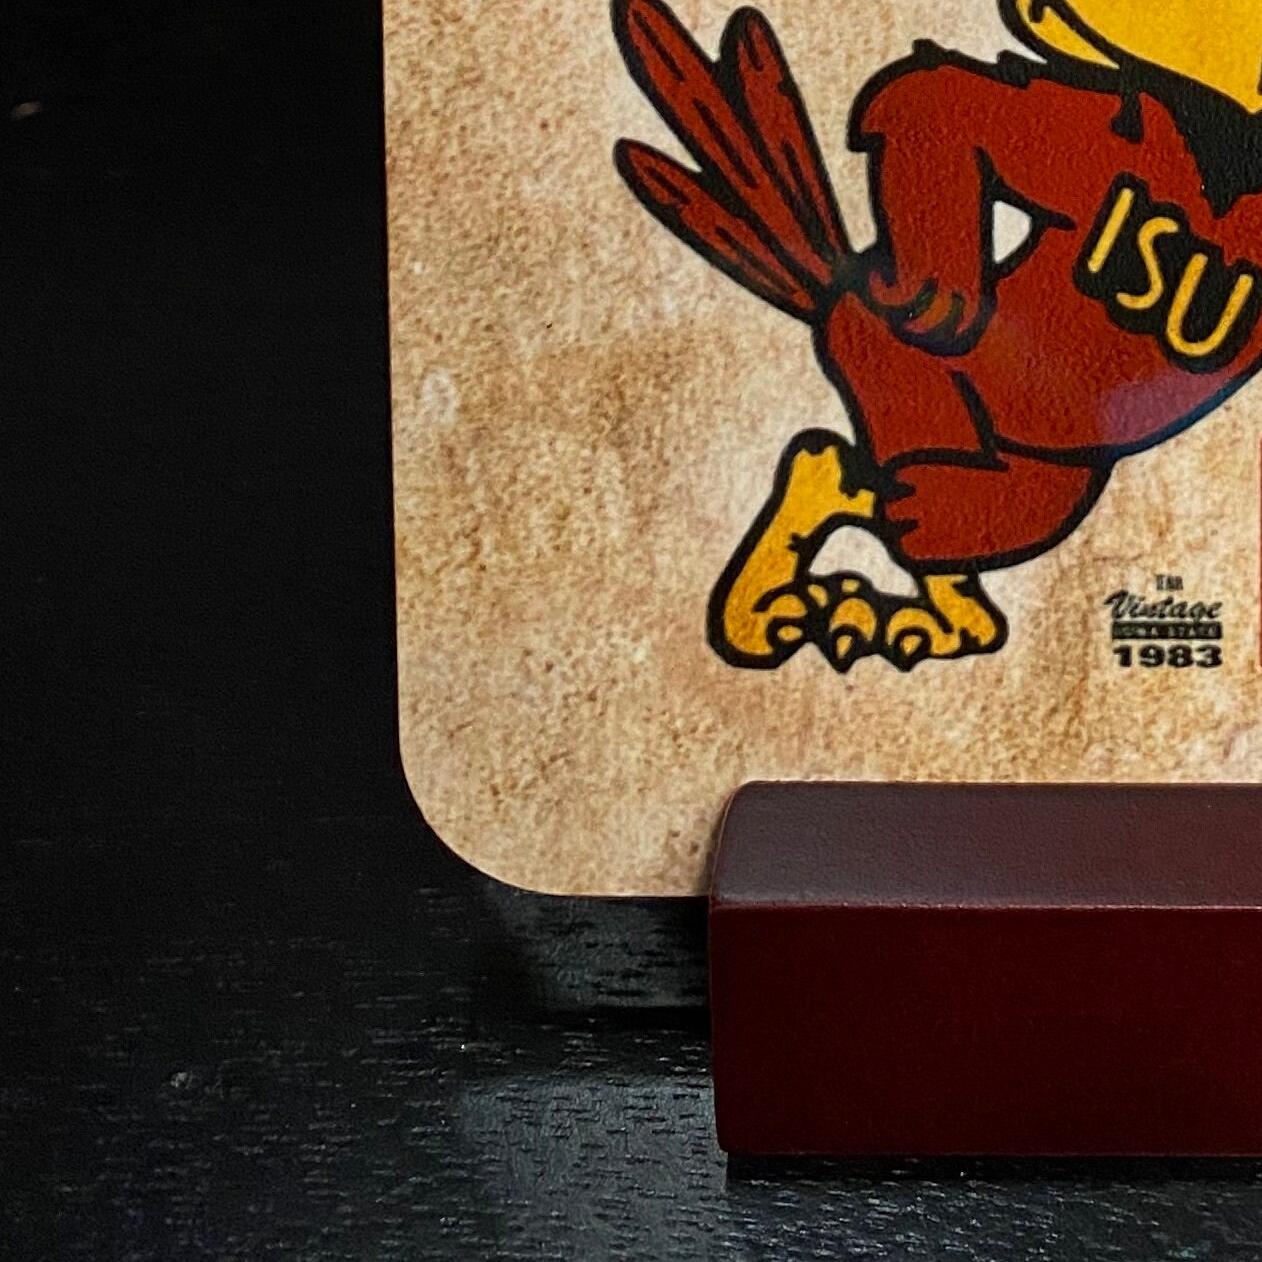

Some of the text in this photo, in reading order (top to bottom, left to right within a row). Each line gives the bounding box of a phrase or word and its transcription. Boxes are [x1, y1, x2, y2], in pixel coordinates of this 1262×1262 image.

[1087, 187, 1253, 357] ISU
[1104, 589, 1223, 625] Vintage
[1112, 644, 1223, 668] 1983
